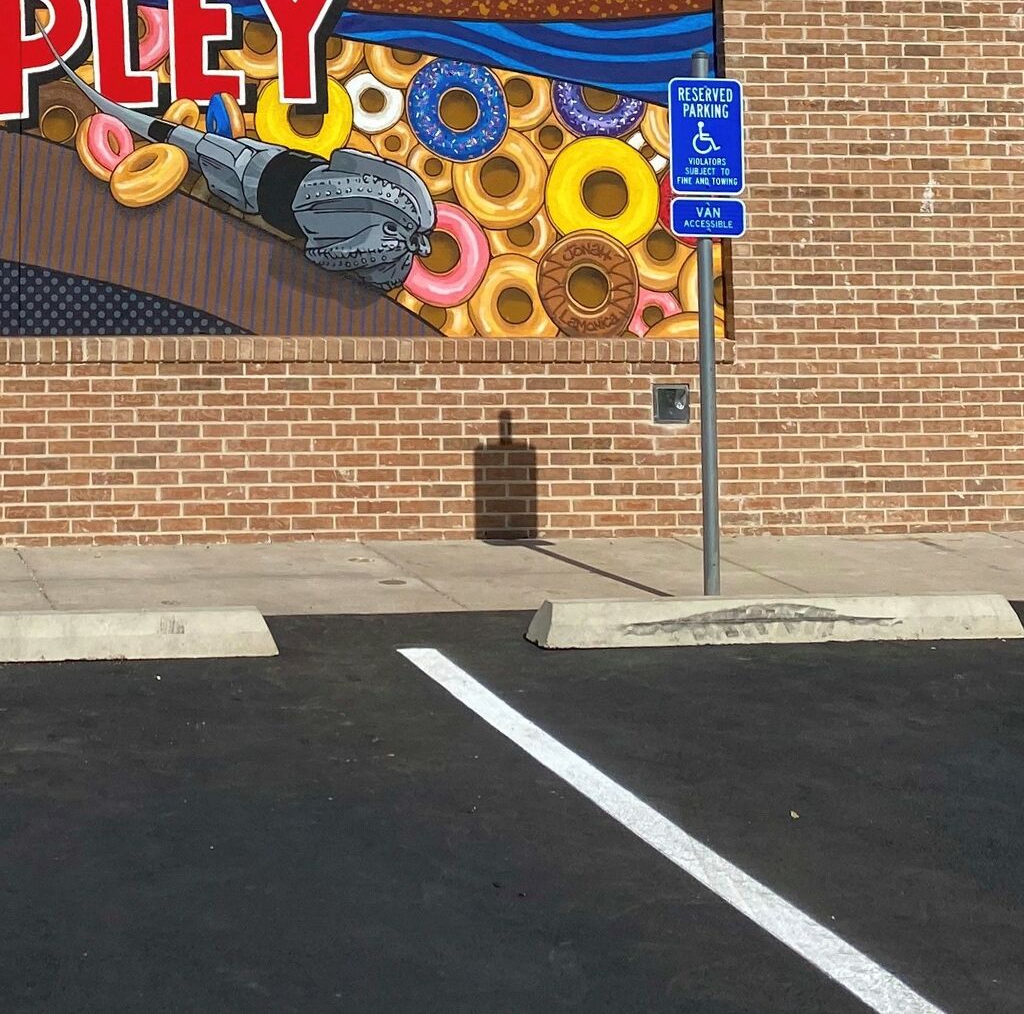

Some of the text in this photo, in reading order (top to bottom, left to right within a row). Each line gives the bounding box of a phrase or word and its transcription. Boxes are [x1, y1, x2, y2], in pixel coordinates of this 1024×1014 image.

[678, 87, 733, 102] RESERVED
[683, 103, 729, 118] PARKING
[688, 157, 727, 166] VIOLATORS
[685, 167, 730, 176] SUBJECT TO
[676, 176, 738, 186] FINE AND TOWING
[695, 207, 721, 218] VAN
[684, 220, 733, 228] ACCESSIBLE
